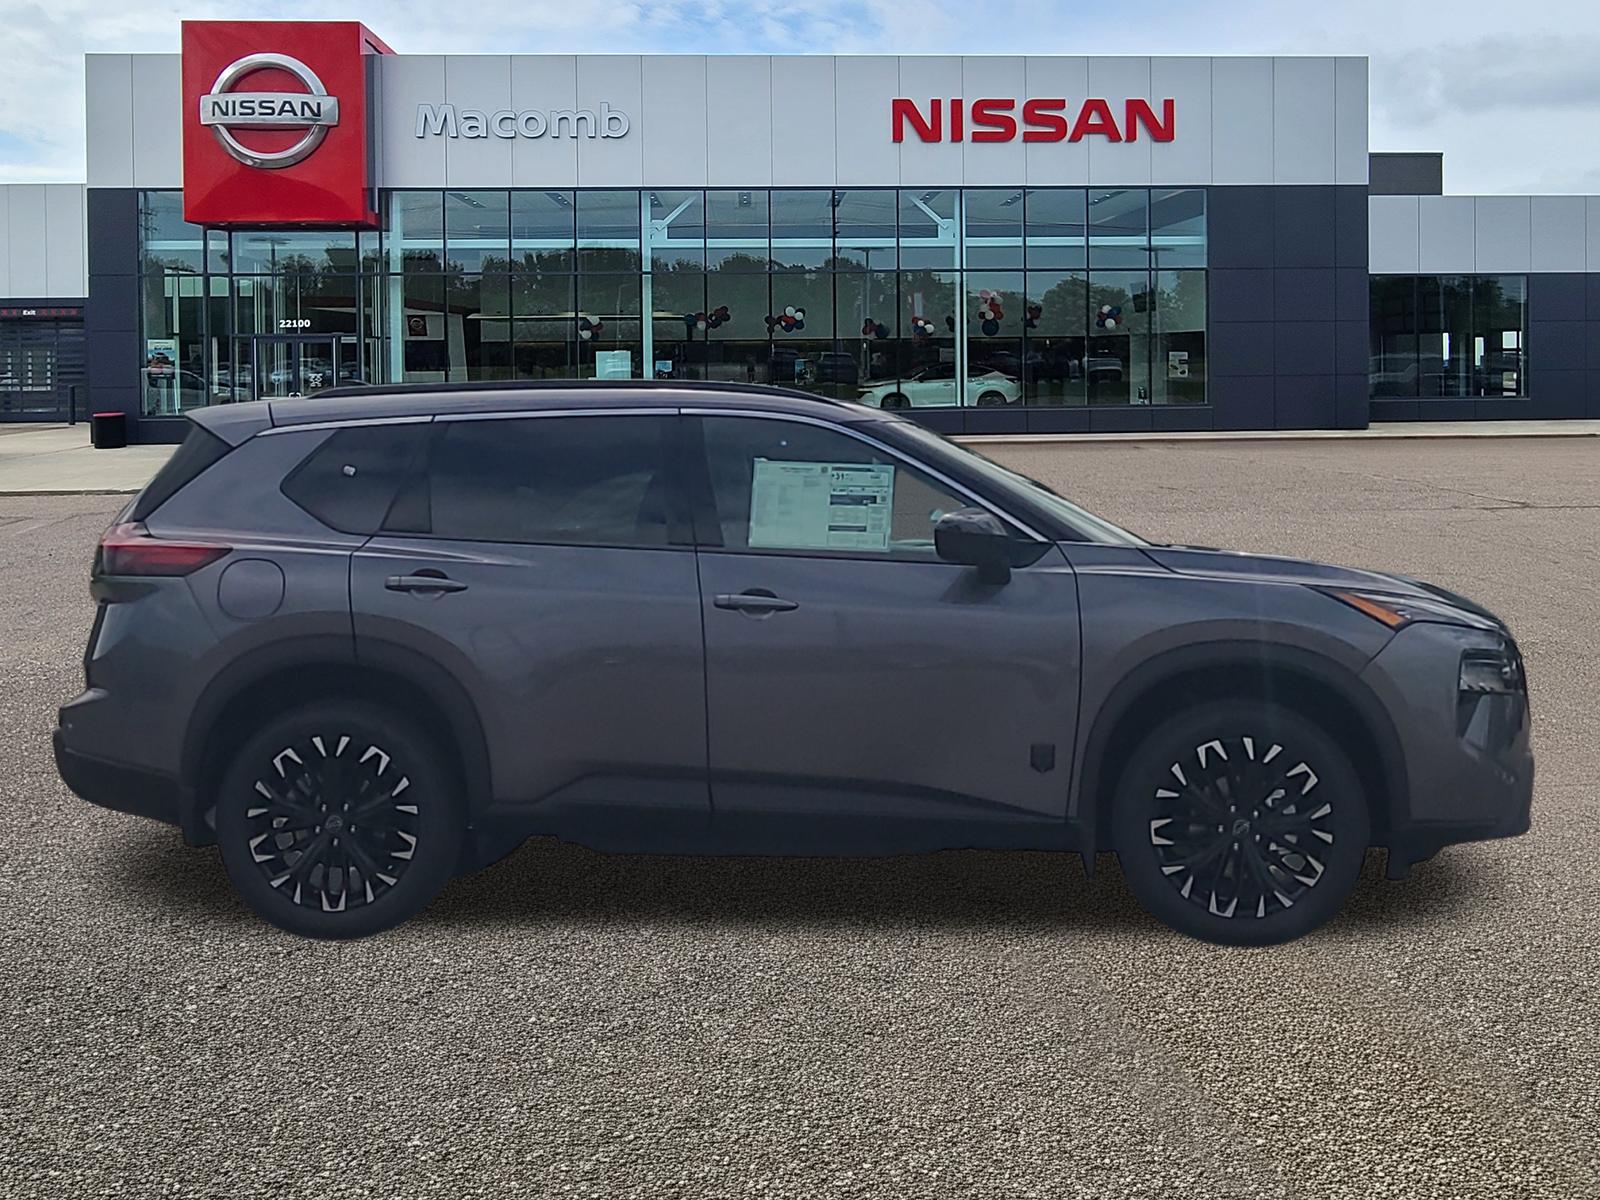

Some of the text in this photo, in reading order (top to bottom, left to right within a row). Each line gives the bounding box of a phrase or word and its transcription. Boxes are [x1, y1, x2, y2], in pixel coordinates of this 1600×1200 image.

[212, 100, 322, 118] NISSAN
[415, 102, 630, 139] Macomb
[892, 98, 1175, 143] NISSAN
[279, 319, 311, 328] 22100
